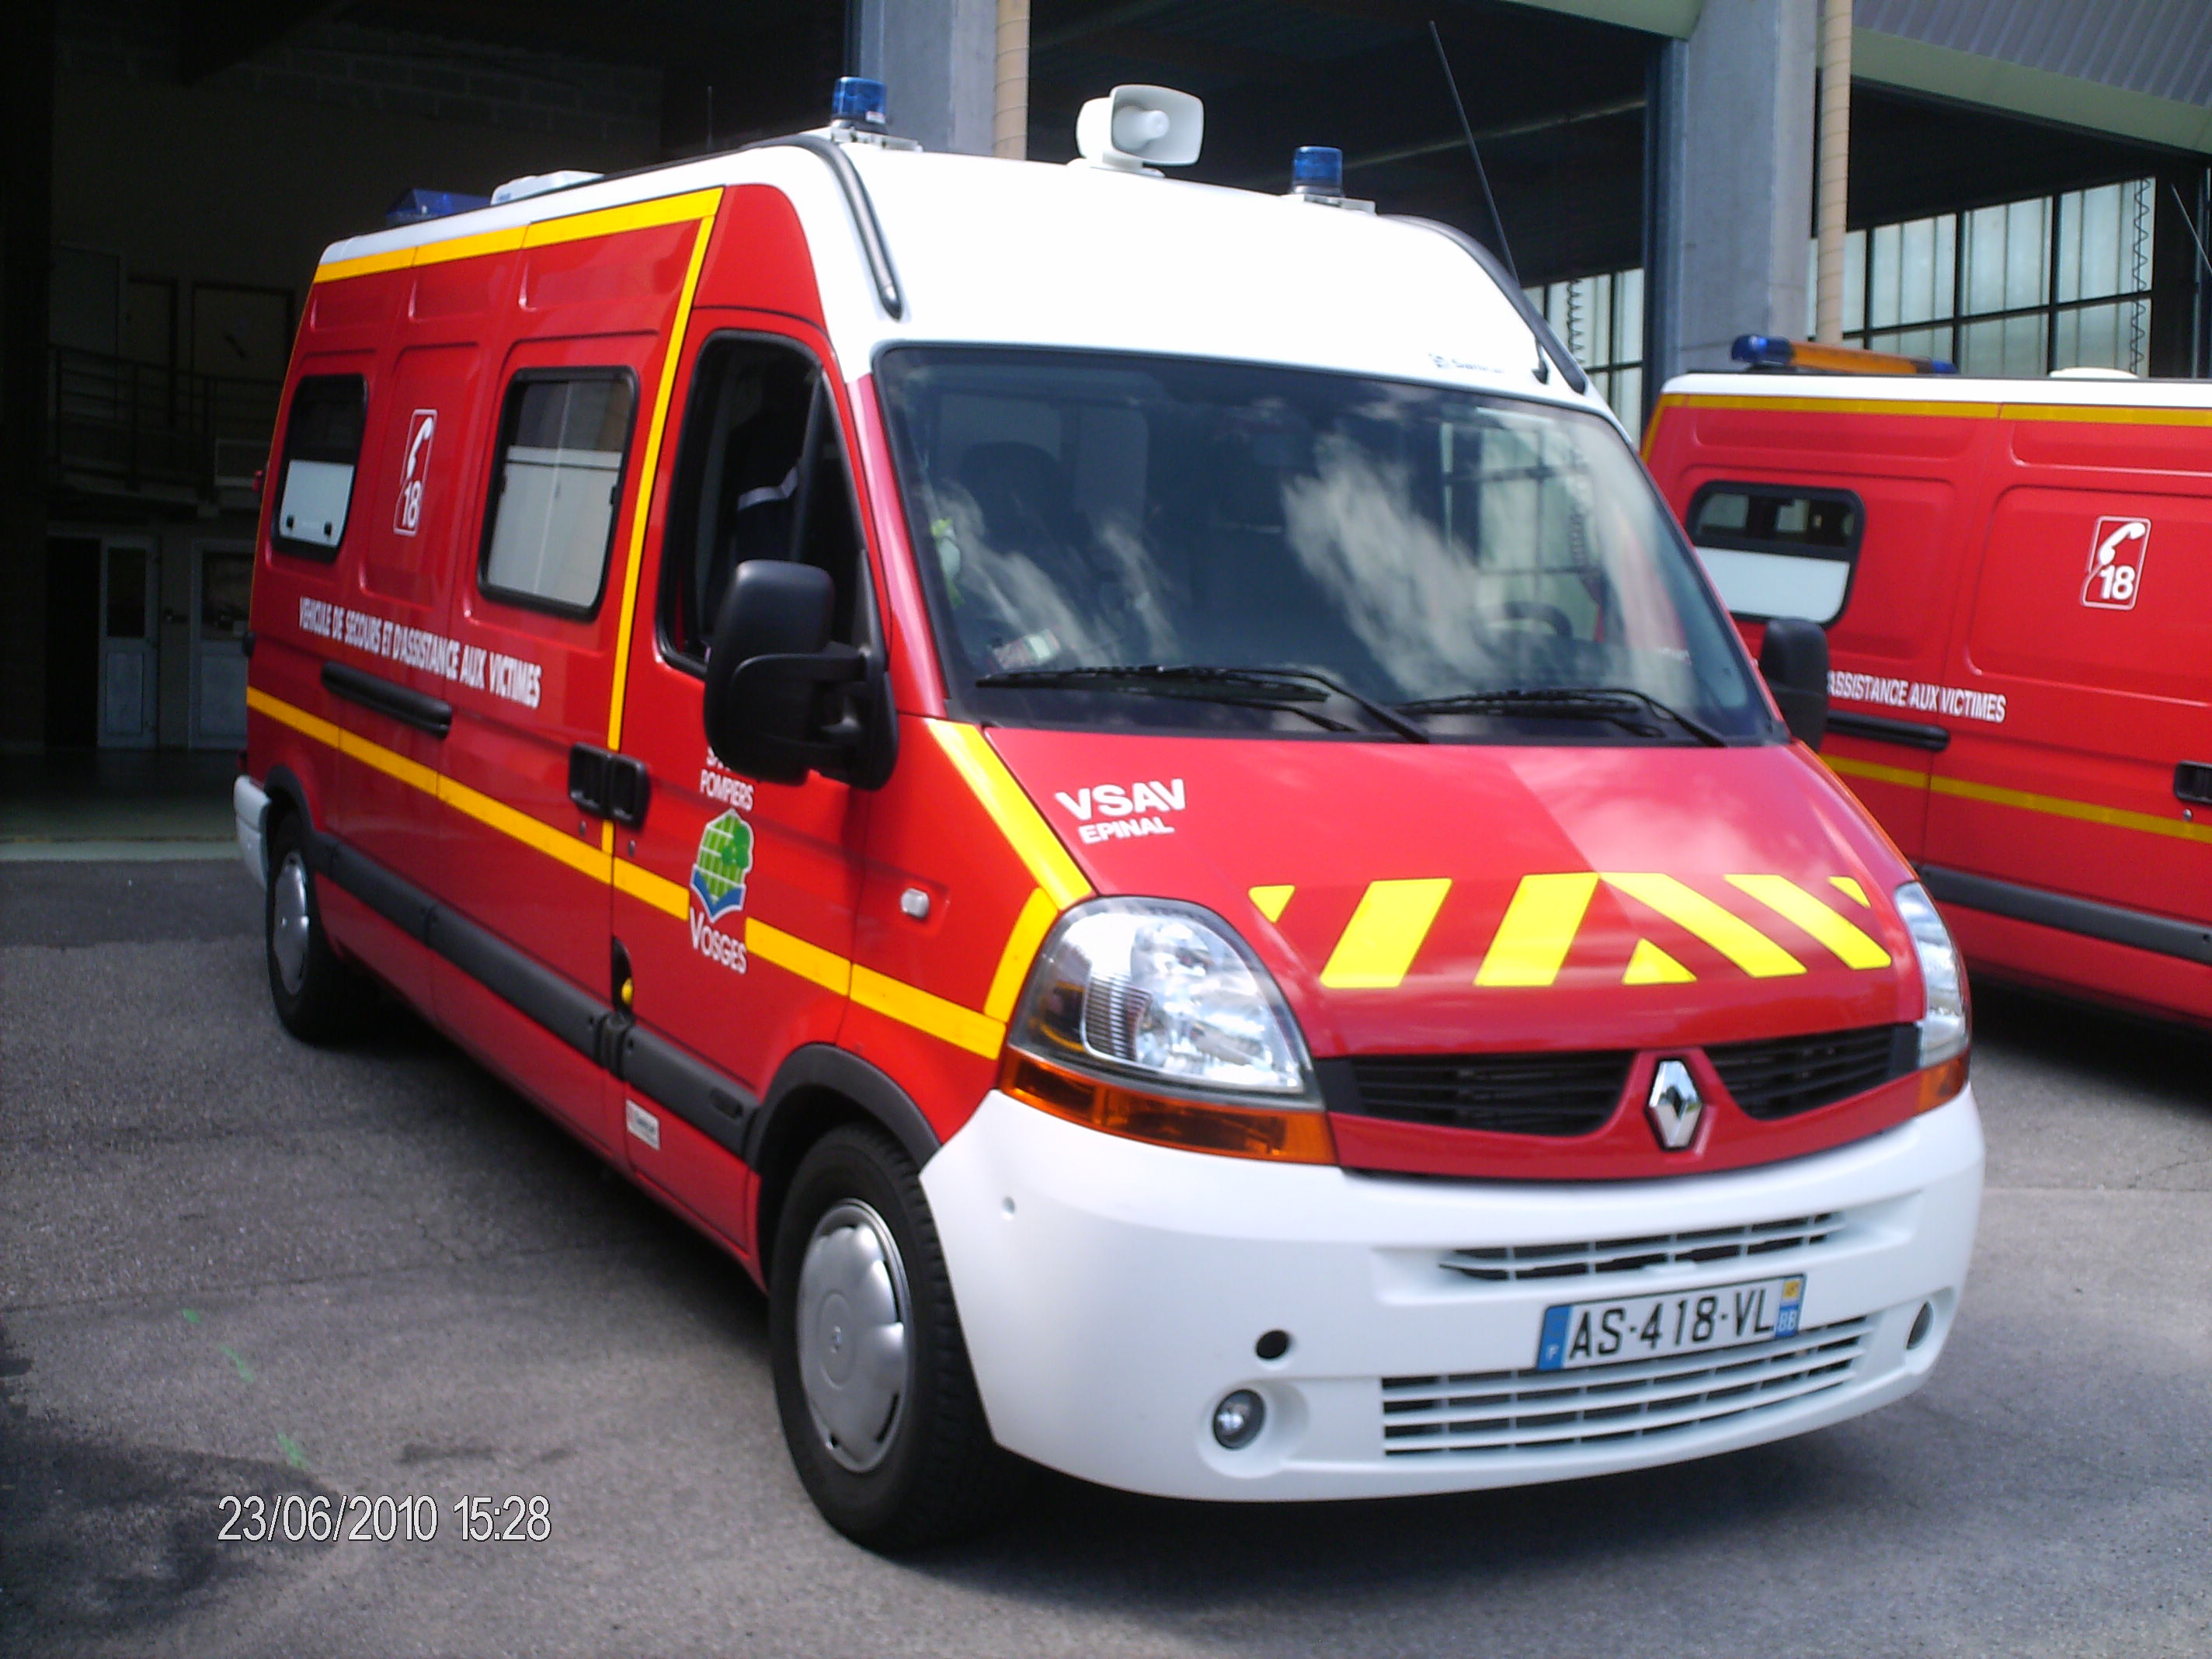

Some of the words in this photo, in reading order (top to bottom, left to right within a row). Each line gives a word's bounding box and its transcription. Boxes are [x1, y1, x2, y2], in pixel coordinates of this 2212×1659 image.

[402, 480, 422, 529] 18
[2099, 565, 2136, 600] 18
[332, 605, 345, 642] DE
[345, 609, 382, 655] SECOURS
[381, 620, 394, 658] ET
[392, 624, 461, 681] D'ASSISTANCE
[459, 644, 488, 690] AUX
[489, 651, 543, 710] VICTIMES
[1907, 682, 1940, 712] AUX
[1939, 686, 2007, 723] VICTIMES
[700, 769, 754, 812] POMPIERS
[1054, 777, 1187, 821] VSAV
[1077, 816, 1176, 845] EPINAL
[1569, 1287, 1775, 1360] AS-418-VL
